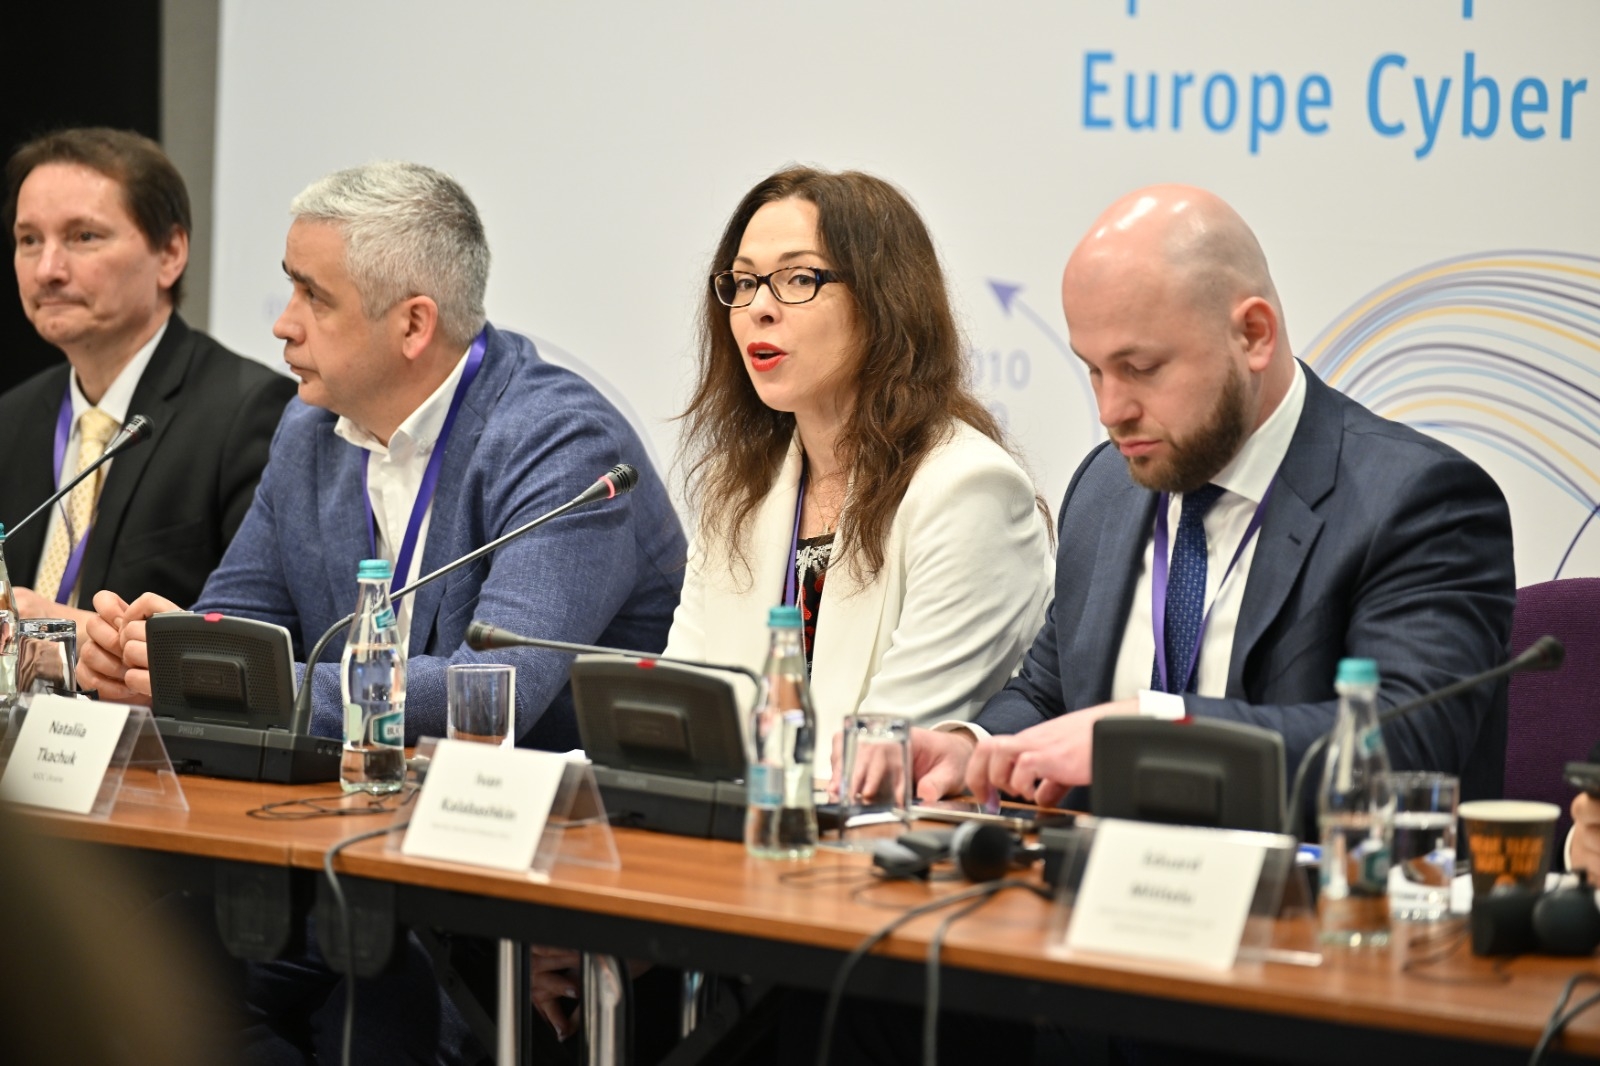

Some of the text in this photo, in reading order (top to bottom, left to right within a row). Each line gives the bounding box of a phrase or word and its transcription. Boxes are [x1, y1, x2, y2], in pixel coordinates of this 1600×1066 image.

[1081, 50, 1590, 161] Europe Cyber
[37, 747, 77, 766] Tkachuk
